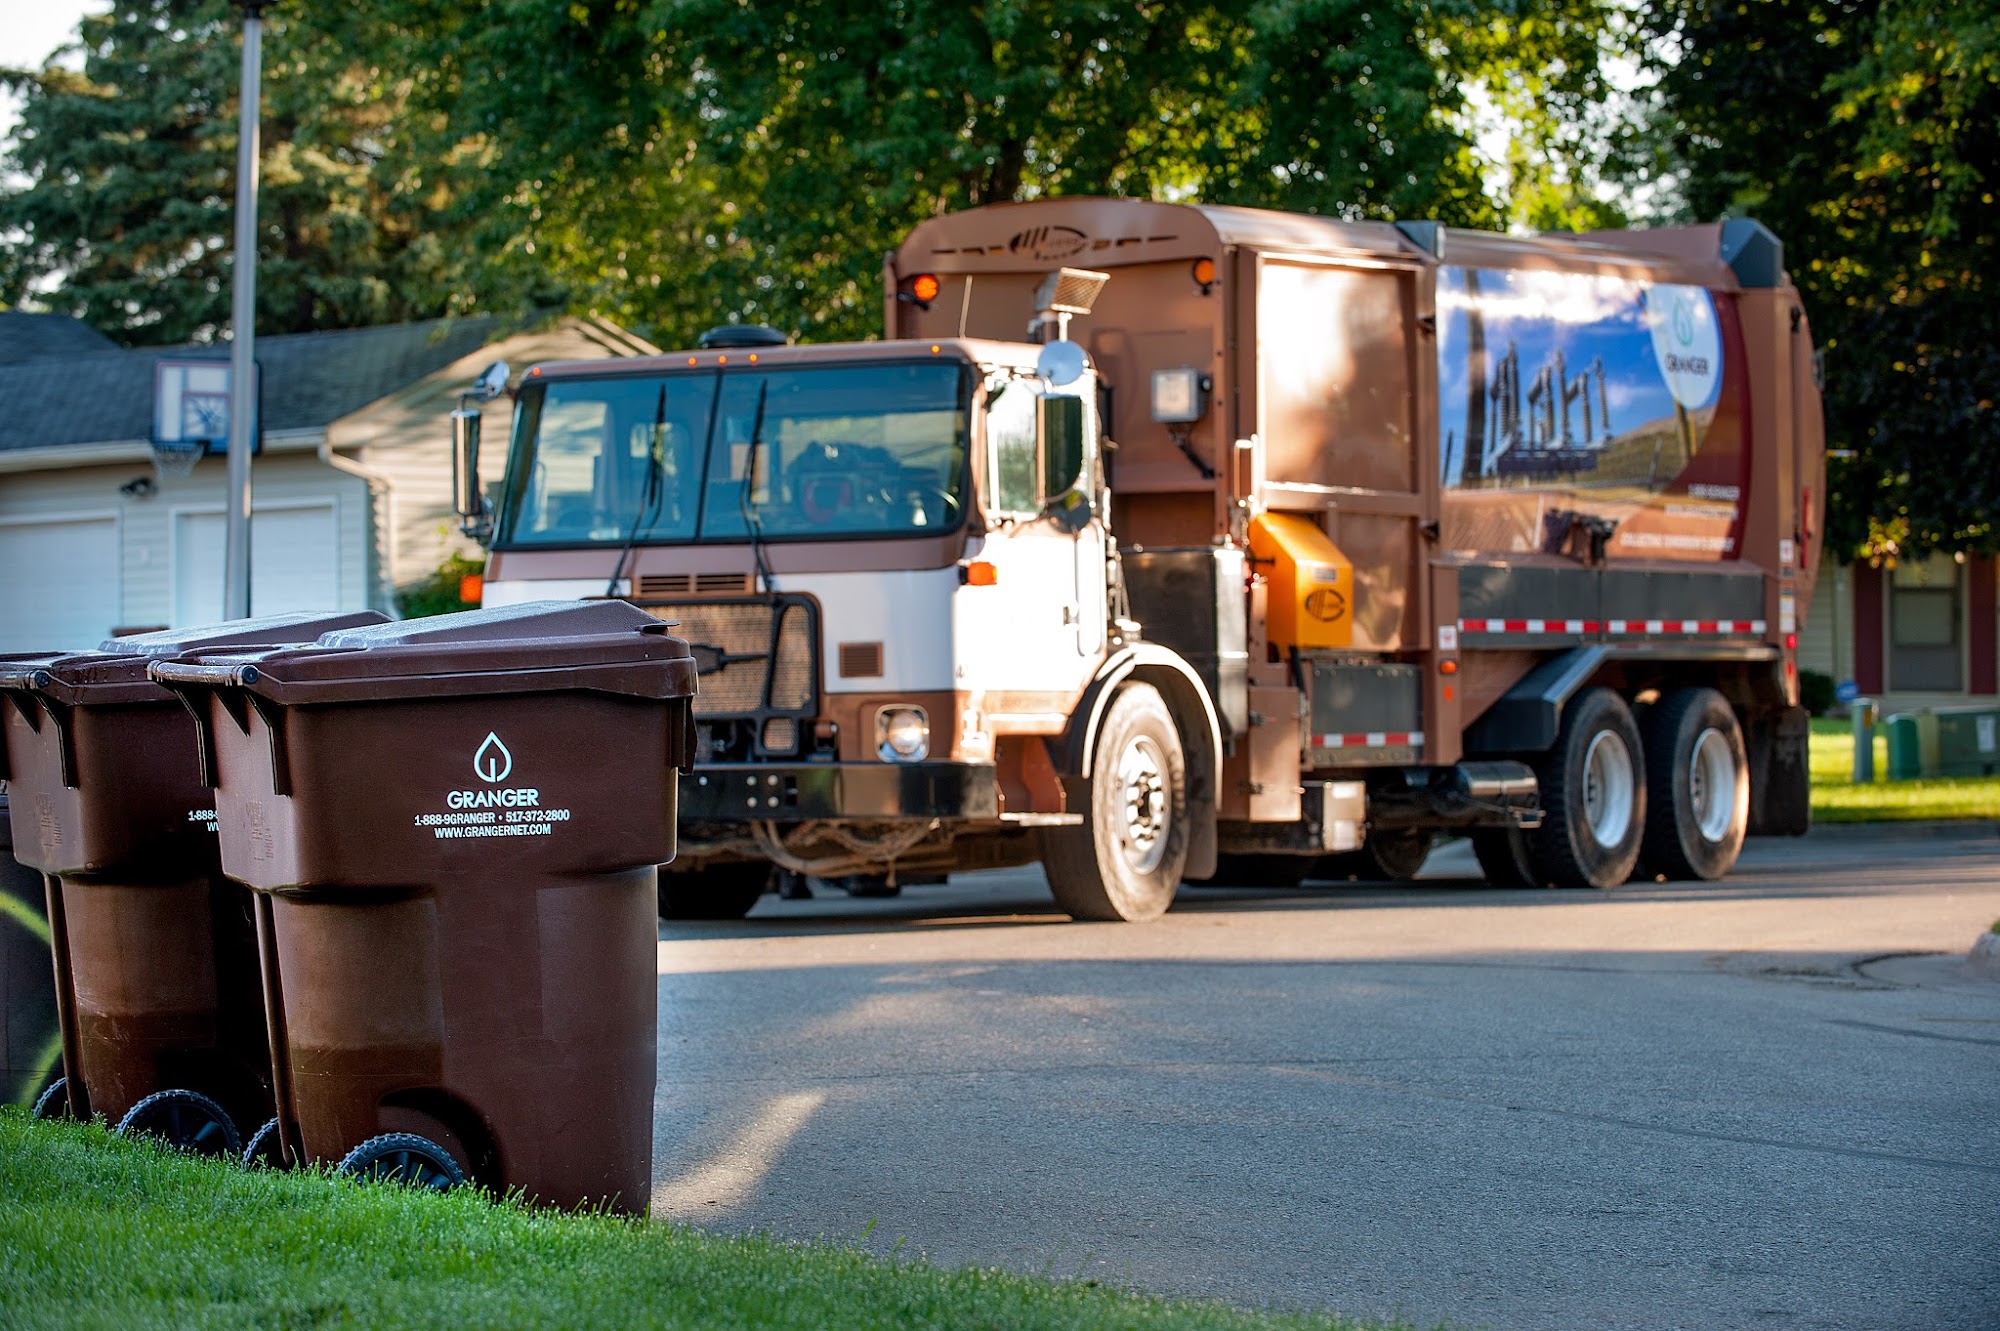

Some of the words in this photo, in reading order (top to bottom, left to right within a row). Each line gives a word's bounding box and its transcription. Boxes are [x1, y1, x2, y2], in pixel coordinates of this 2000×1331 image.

[447, 788, 539, 809] GRANGER
[414, 811, 495, 826] 1-888-9GRANGER
[505, 809, 571, 823] 517-372-2800
[434, 823, 552, 839] WWW.GRANGERNET.COM
